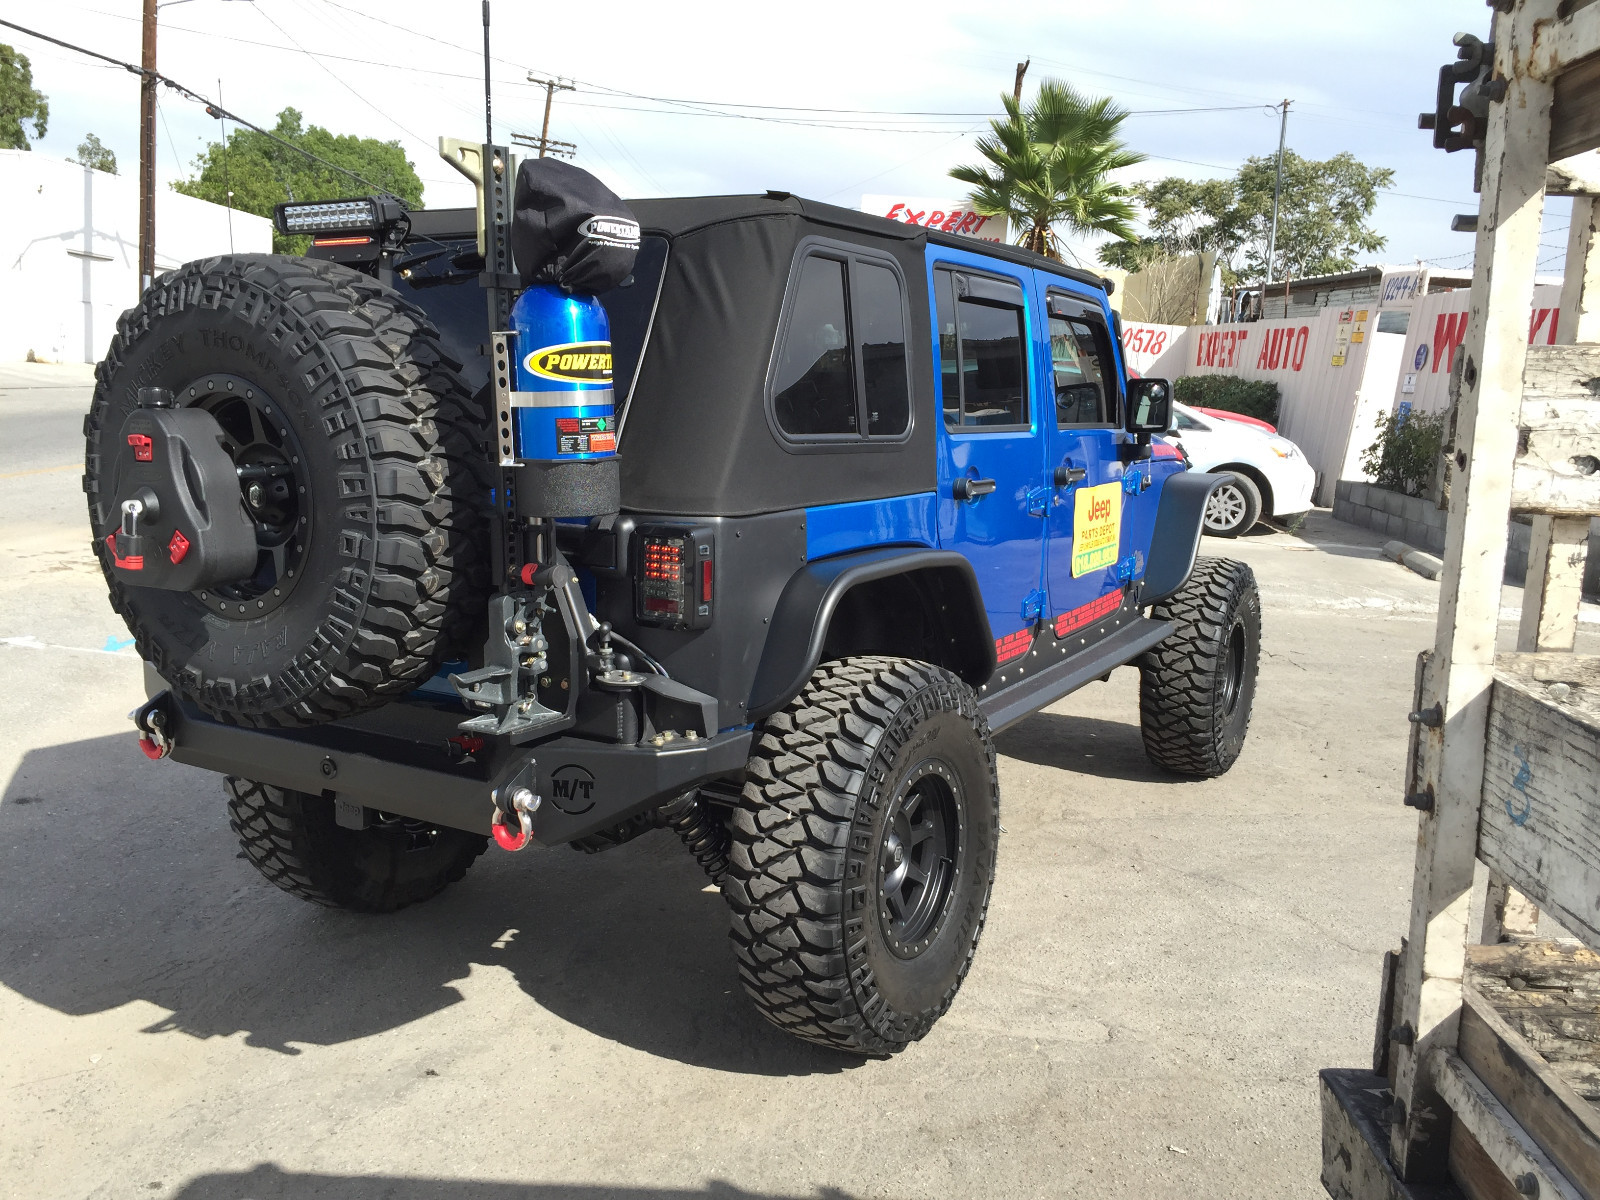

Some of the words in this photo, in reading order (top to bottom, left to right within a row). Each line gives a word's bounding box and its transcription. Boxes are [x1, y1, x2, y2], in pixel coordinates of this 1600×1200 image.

[885, 203, 992, 235] EXPERT
[1197, 330, 1248, 369] EXPERT
[1256, 326, 1310, 372] AUTO
[545, 353, 613, 371] POWERT
[1088, 496, 1111, 523] Jeep
[1081, 526, 1099, 540] PARTS
[1099, 522, 1116, 537] DEPOT
[552, 778, 594, 801] M/T
